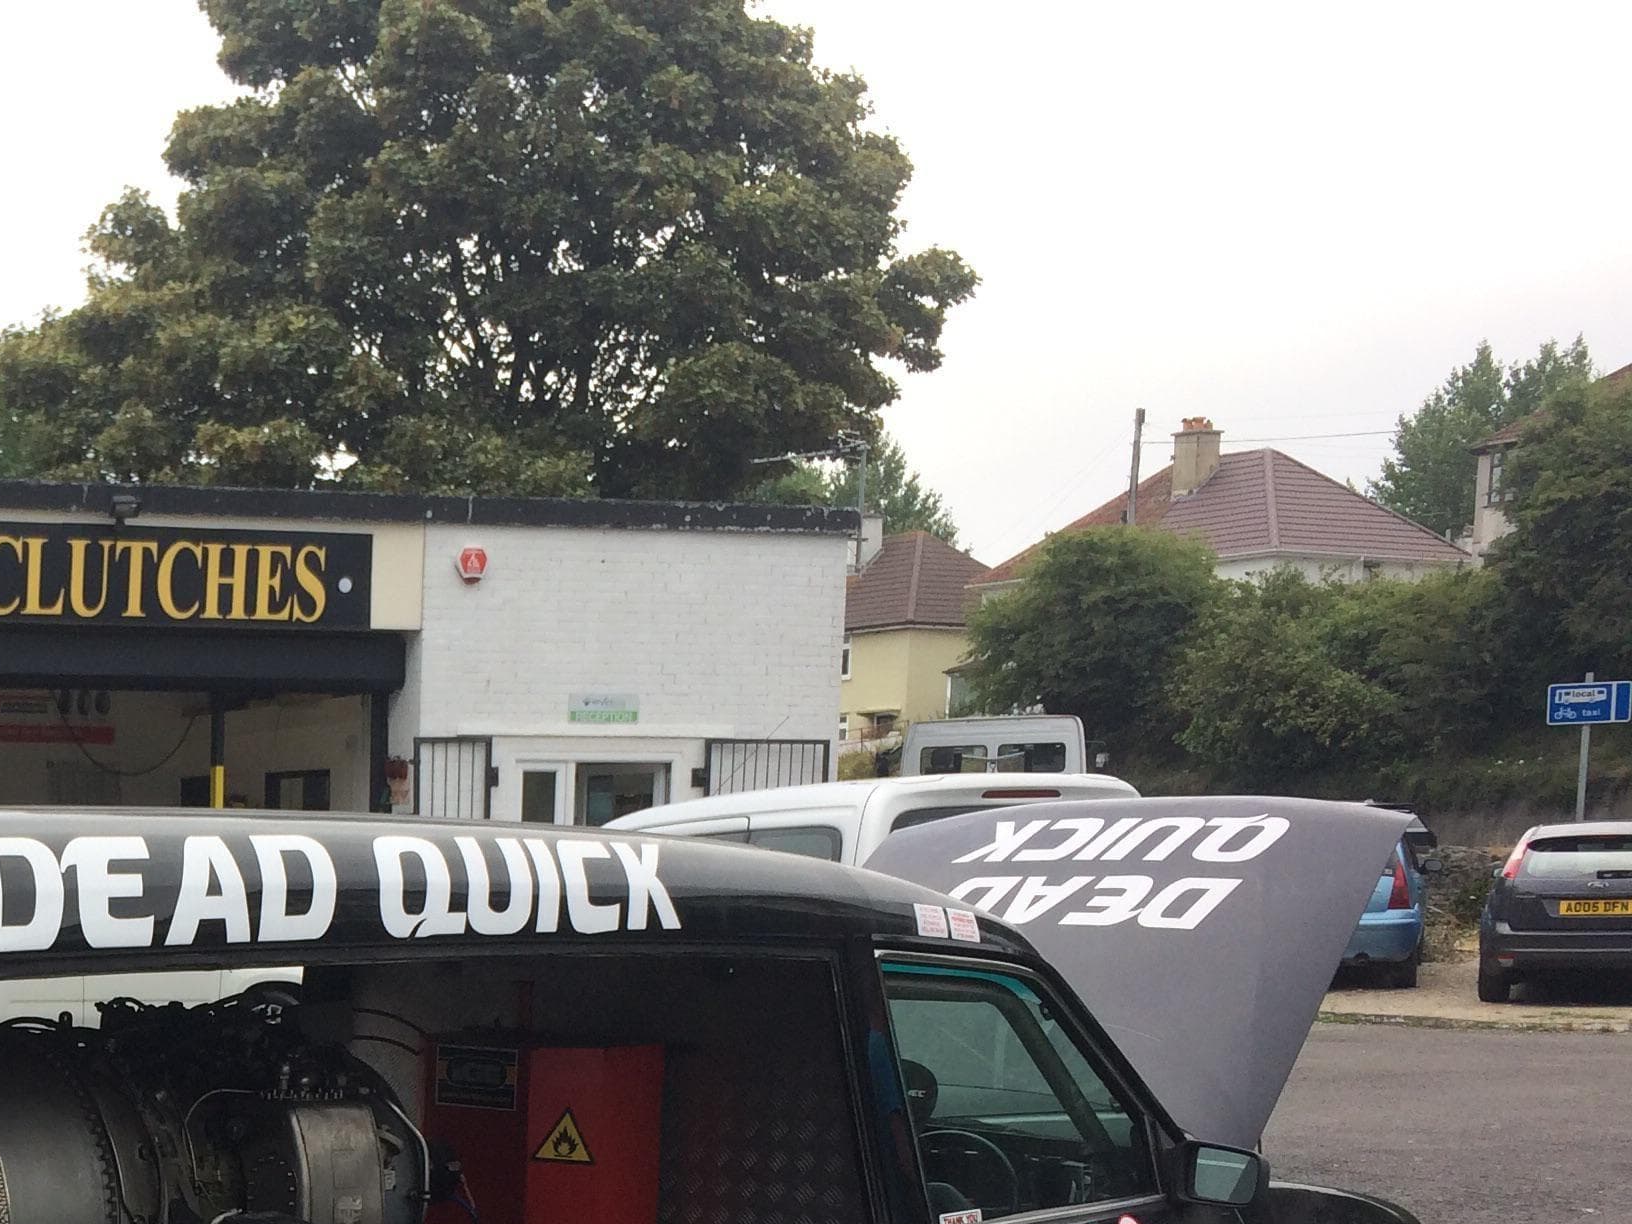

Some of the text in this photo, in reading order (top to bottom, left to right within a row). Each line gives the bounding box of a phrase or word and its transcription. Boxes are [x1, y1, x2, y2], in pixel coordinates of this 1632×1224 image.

[1572, 690, 1596, 698] local
[1582, 708, 1601, 717] taxi
[951, 813, 1291, 863] QUICK
[372, 836, 683, 938] QUICK
